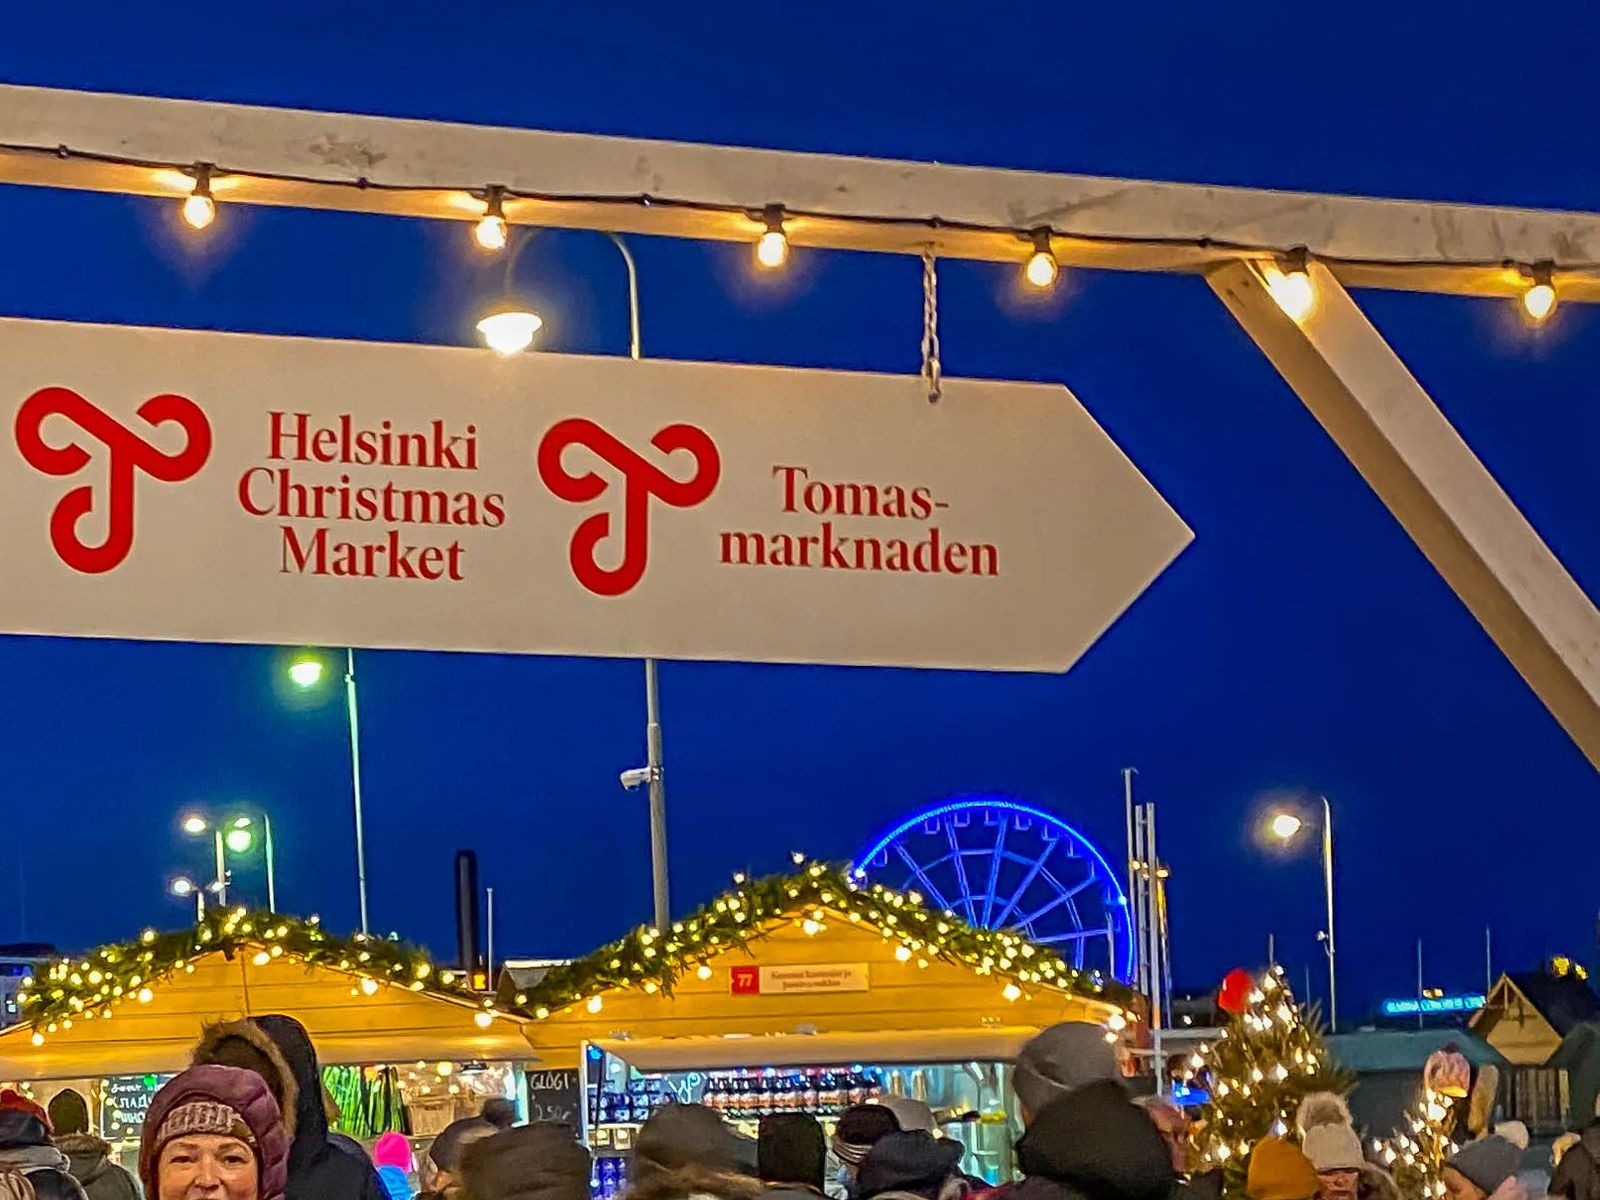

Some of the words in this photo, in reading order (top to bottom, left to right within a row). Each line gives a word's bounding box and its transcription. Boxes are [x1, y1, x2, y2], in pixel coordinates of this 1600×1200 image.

[268, 409, 478, 471] Helsinki
[237, 467, 505, 527] Christmas
[771, 465, 950, 518] Tomas-
[280, 524, 464, 582] Market
[720, 522, 1000, 577] marknaden
